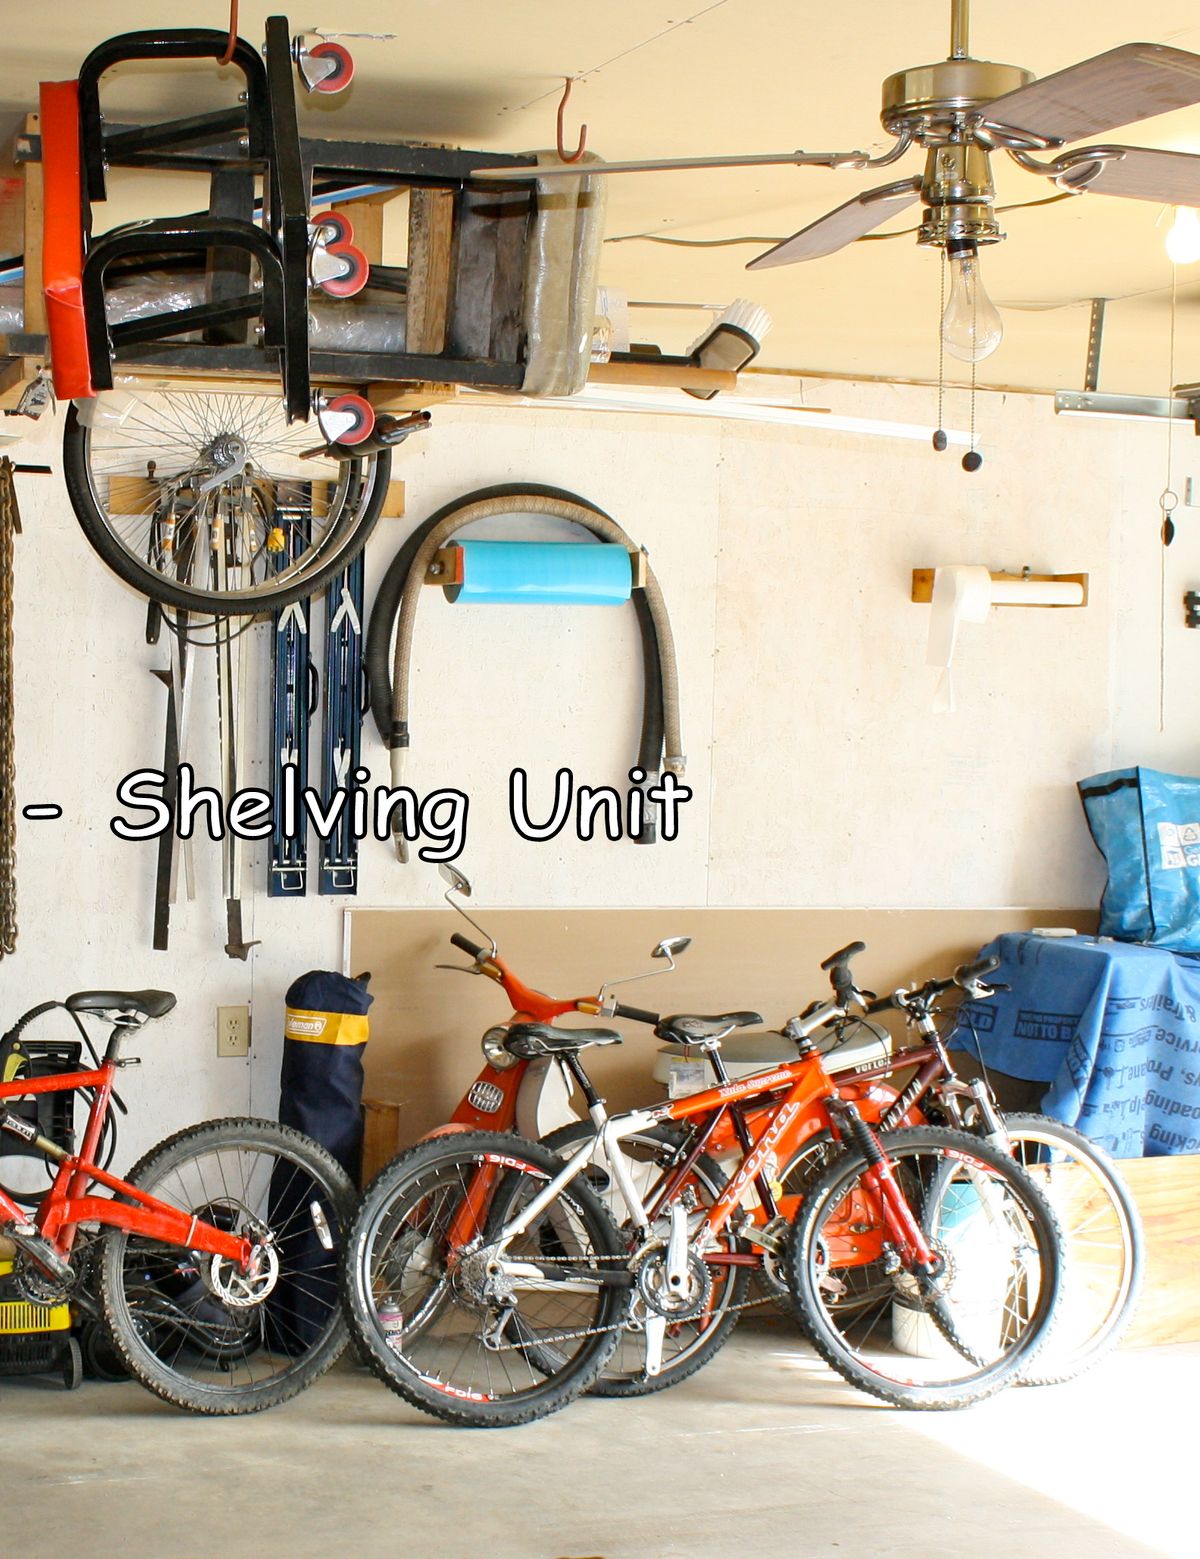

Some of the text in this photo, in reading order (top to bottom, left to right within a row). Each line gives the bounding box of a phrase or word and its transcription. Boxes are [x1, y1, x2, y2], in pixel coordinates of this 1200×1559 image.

[1140, 993, 1185, 1021] Trailers
[1184, 1004, 1197, 1023] &
[1155, 1027, 1200, 1054] rvice
[1148, 1122, 1200, 1152] cking
